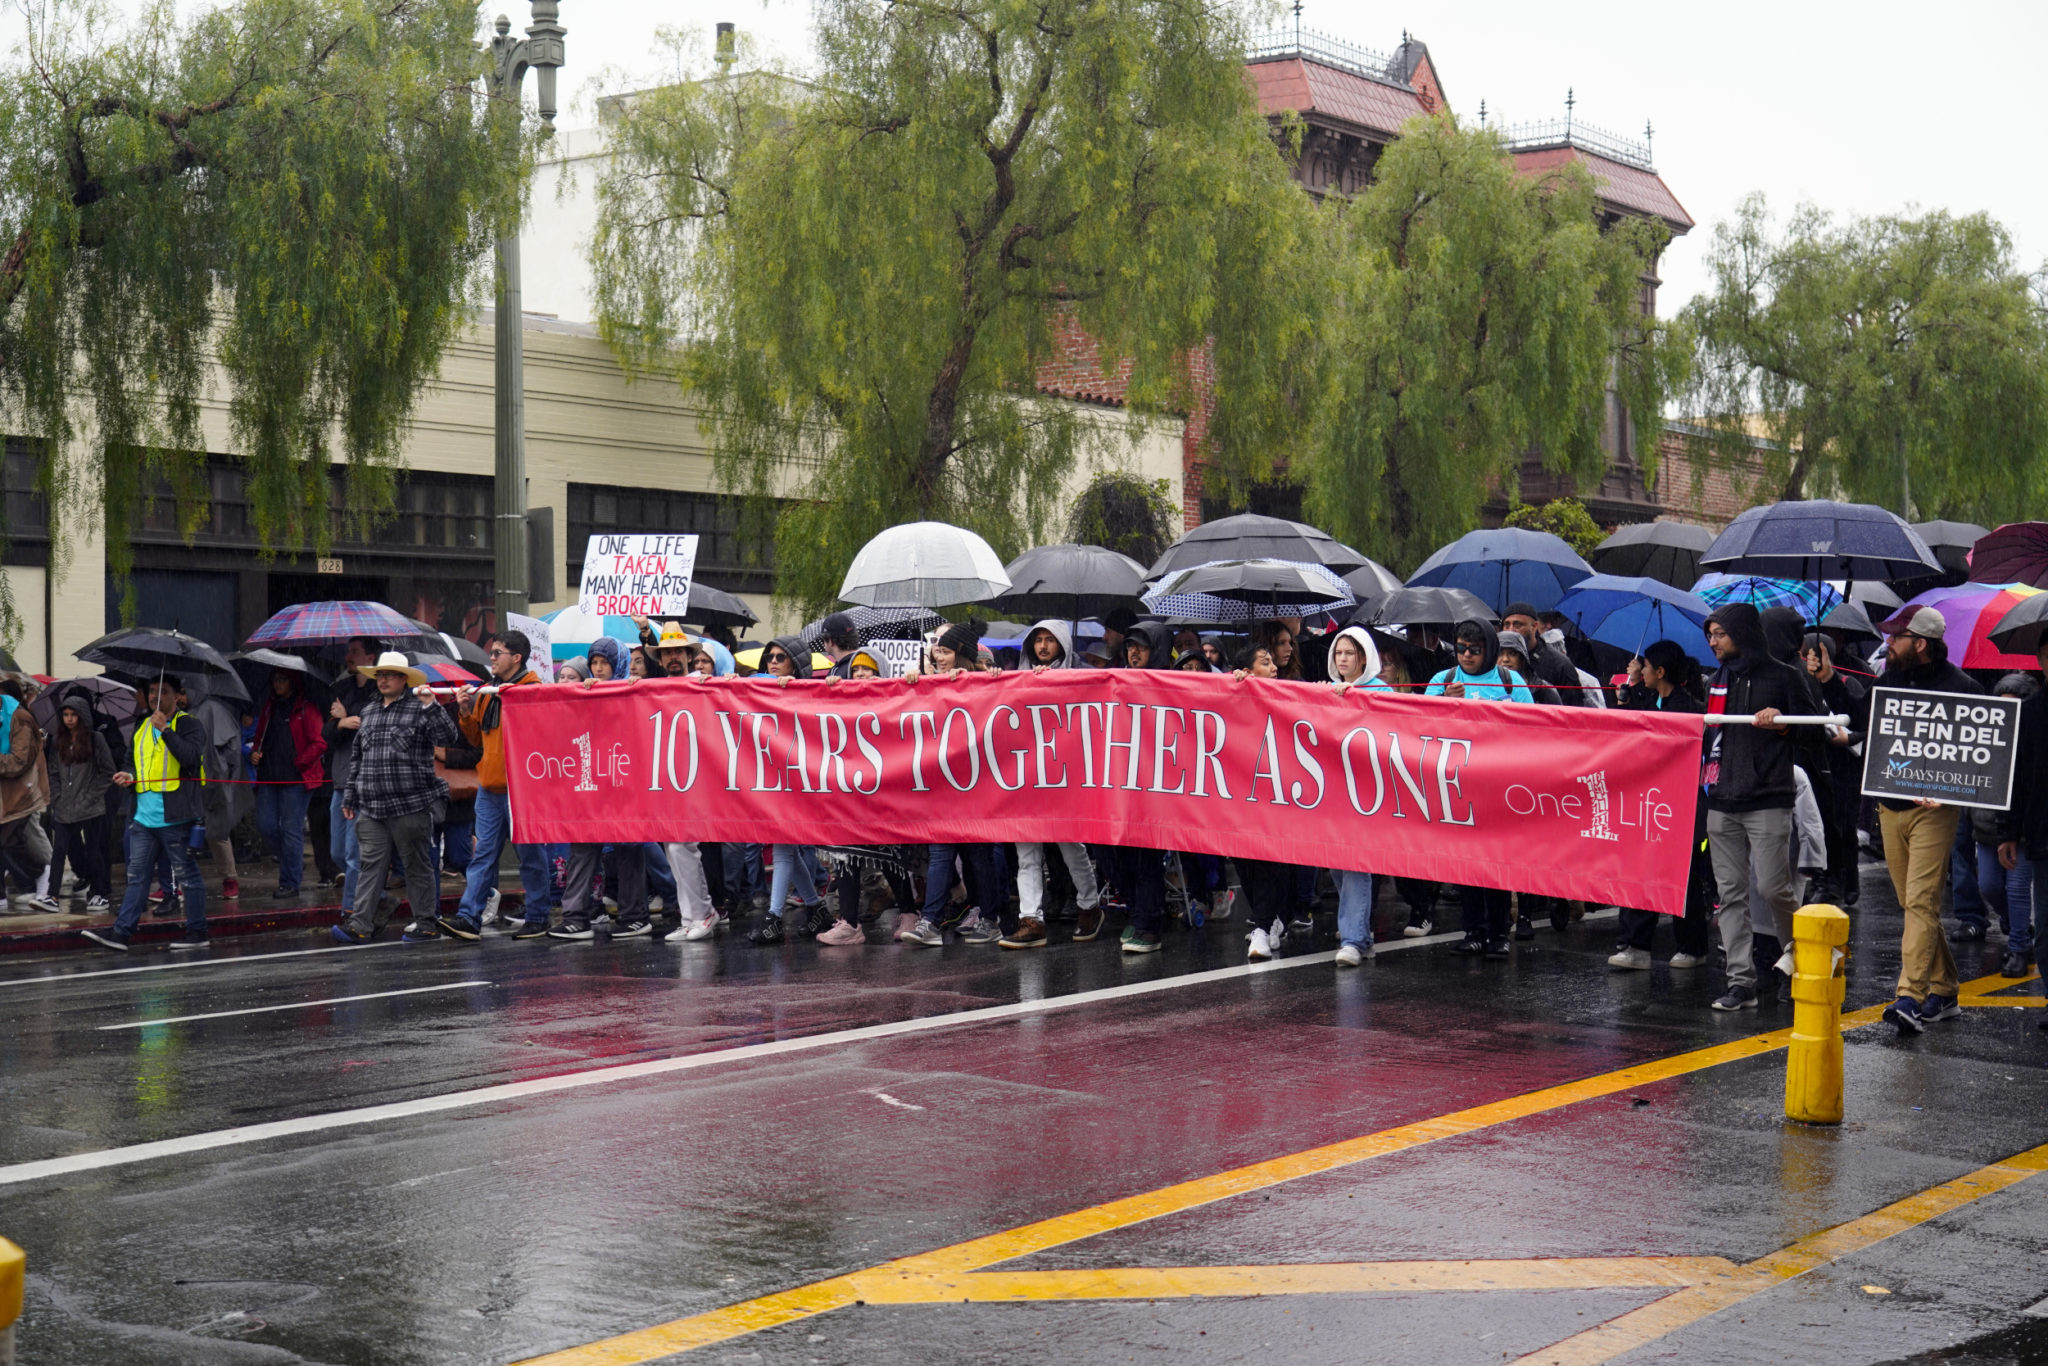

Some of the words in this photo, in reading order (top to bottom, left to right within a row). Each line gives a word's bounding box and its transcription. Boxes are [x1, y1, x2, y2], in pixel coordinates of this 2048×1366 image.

[599, 536, 630, 555] ONE
[642, 536, 685, 556] LIFE
[322, 560, 341, 571] 628
[614, 555, 670, 575] TAKEN.
[585, 575, 627, 595] MANY
[631, 575, 688, 596] HEARTS
[597, 595, 666, 616] BROKEN.
[1885, 698, 1948, 721] REZA
[1955, 705, 2006, 726] POR
[1880, 718, 1907, 737] EL
[1914, 721, 1953, 741] FIN
[1960, 726, 2006, 747] DEL
[1888, 739, 1991, 765] ABORTO
[526, 752, 576, 779] One
[597, 743, 631, 787] Life
[648, 709, 699, 792] 10
[715, 711, 883, 795] YEARS
[900, 702, 1233, 800] TOGETHER
[1246, 713, 1325, 810] AS
[1341, 727, 1476, 827] ONE
[1902, 767, 1934, 782] DAYS
[1935, 771, 1962, 785] FOR
[1964, 774, 1993, 789] LIFE
[1505, 784, 1582, 819] One
[1619, 787, 1673, 841] Life
[1650, 833, 1662, 842] LA
